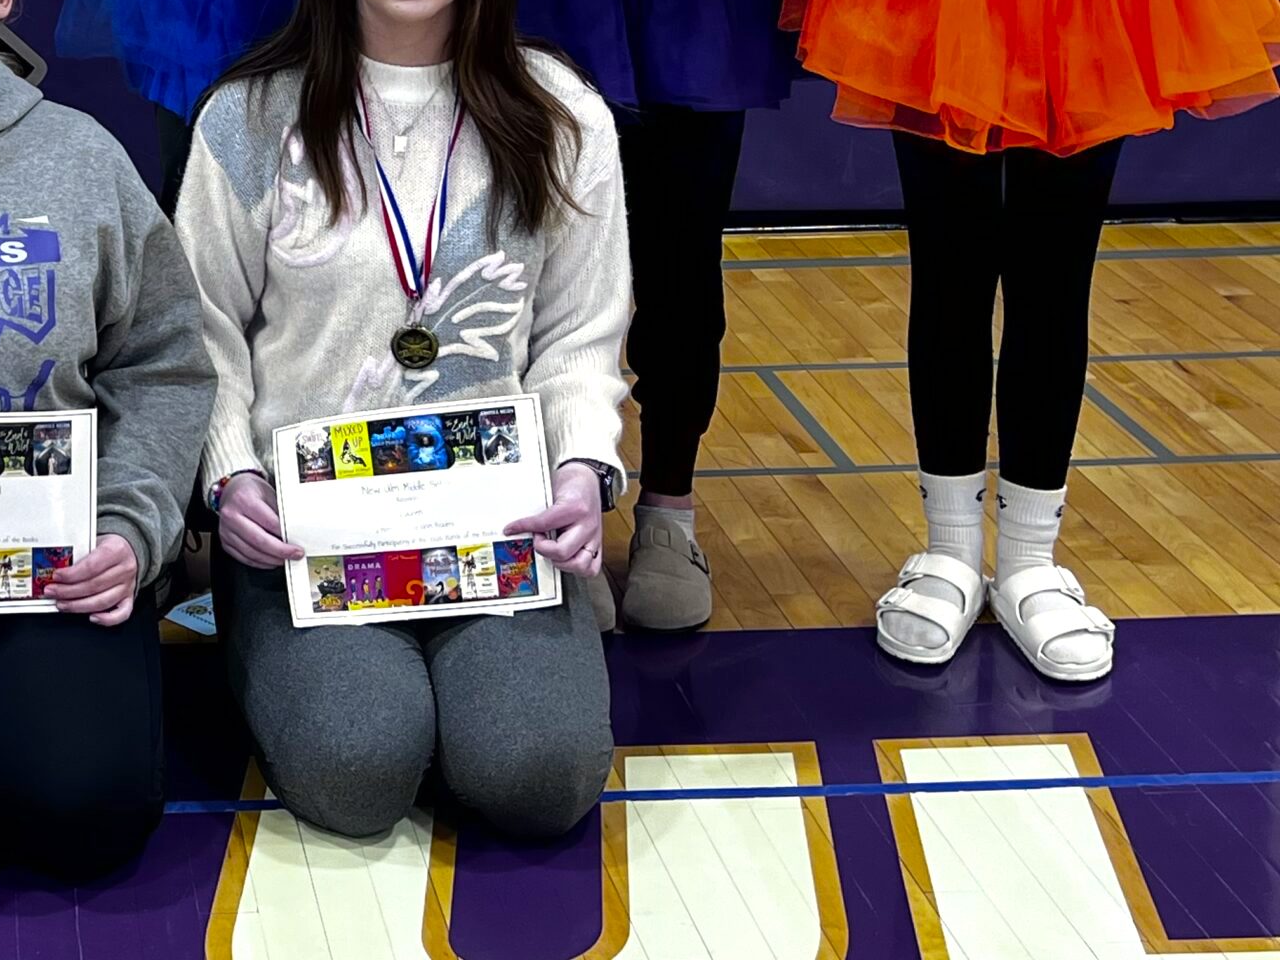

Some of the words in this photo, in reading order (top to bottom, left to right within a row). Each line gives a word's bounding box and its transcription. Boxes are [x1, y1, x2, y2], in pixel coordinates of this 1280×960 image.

[334, 423, 364, 439] MIXED
[352, 436, 363, 449] UP
[347, 561, 381, 571] DRAMA
